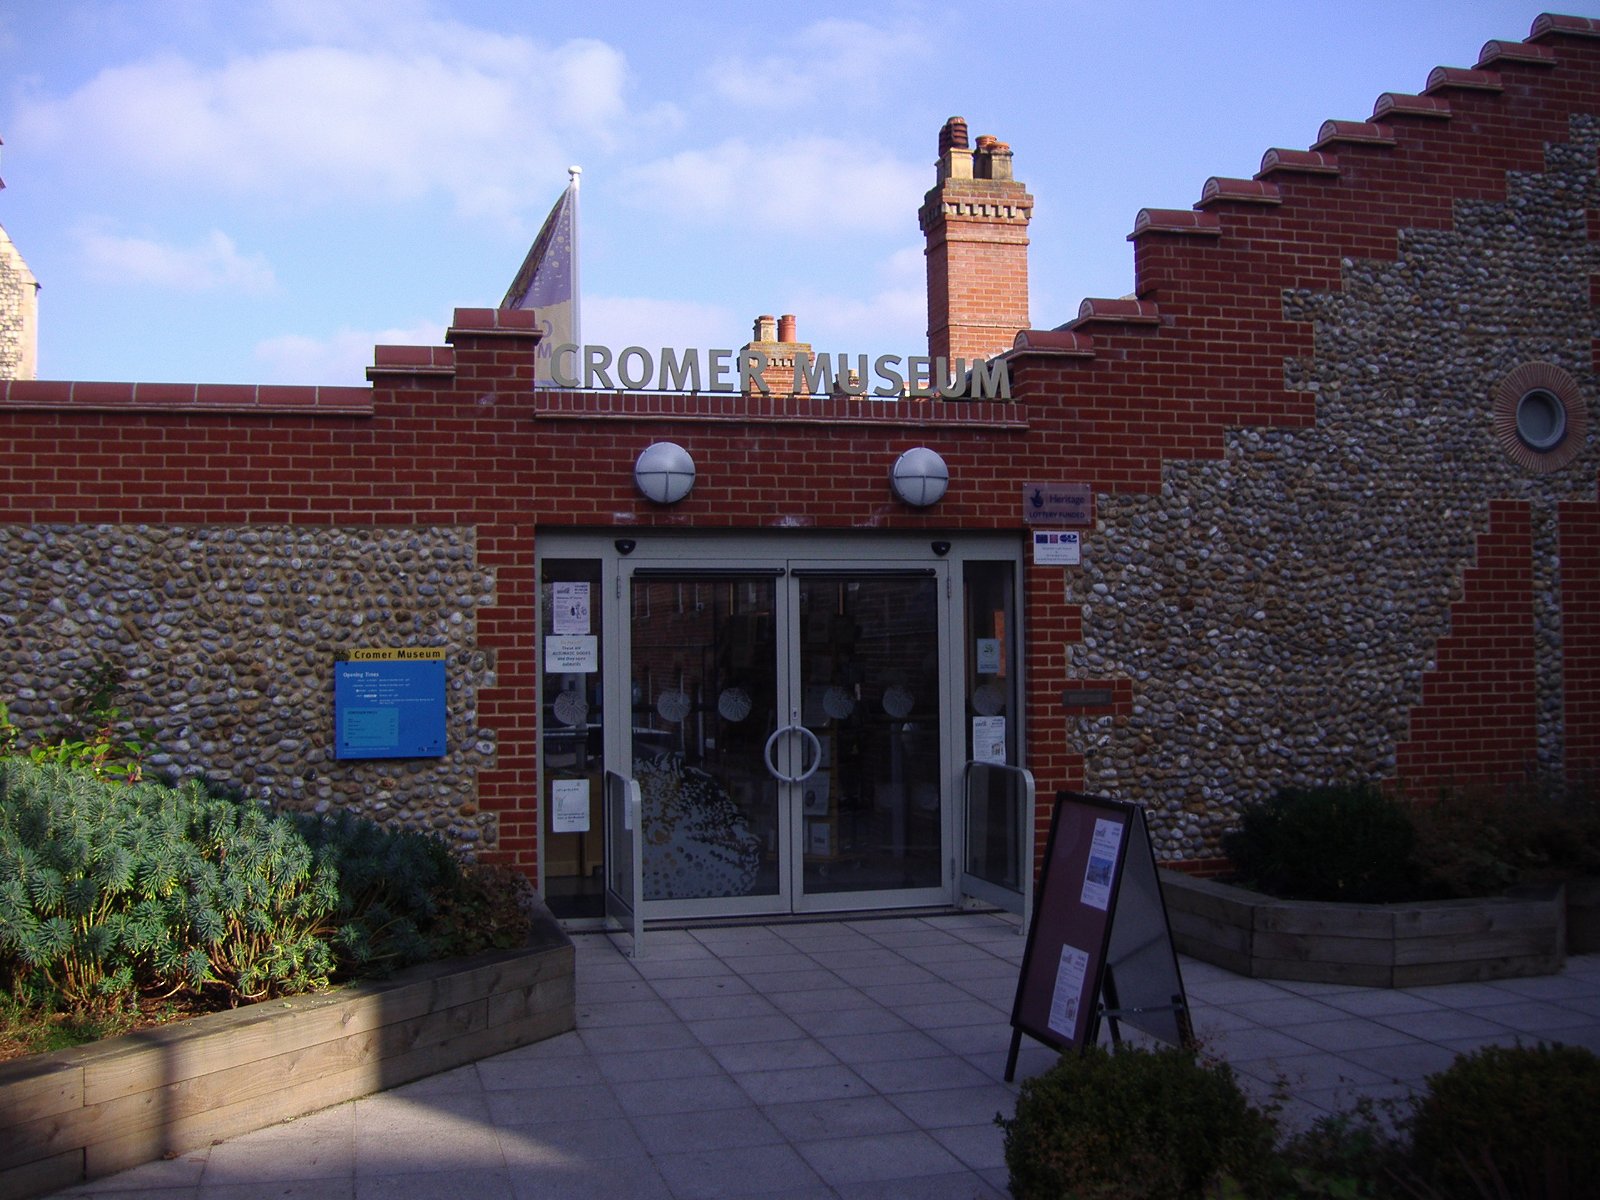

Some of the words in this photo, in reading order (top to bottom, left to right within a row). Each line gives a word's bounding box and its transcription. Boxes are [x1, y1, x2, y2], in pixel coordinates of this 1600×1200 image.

[549, 343, 770, 392] CROMER
[793, 352, 1011, 400] MUSEUM
[1049, 494, 1085, 505] Heritage
[1029, 511, 1057, 519] LOTTERY
[1059, 511, 1085, 519] FUNDED
[354, 650, 392, 659] Cromer
[397, 650, 441, 659] Museum
